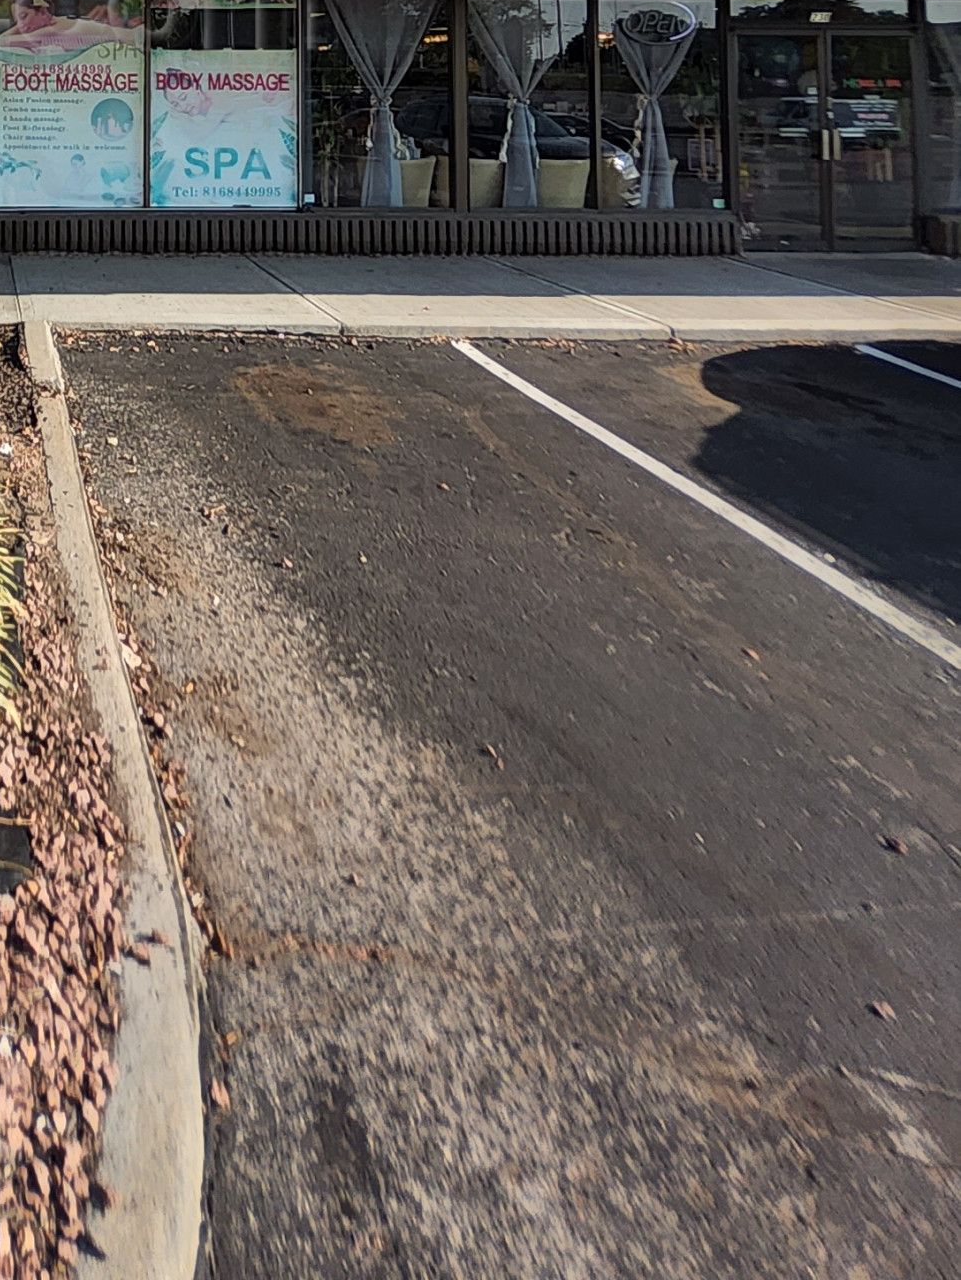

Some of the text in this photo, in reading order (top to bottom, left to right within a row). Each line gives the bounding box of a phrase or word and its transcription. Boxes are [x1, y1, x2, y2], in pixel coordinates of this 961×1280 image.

[4, 73, 51, 91] FOOT
[55, 73, 139, 91] MASSAGE
[156, 73, 203, 91] BODY
[208, 73, 290, 91] MASSAGE
[184, 147, 272, 180] SPA
[172, 186, 198, 197] Tel:
